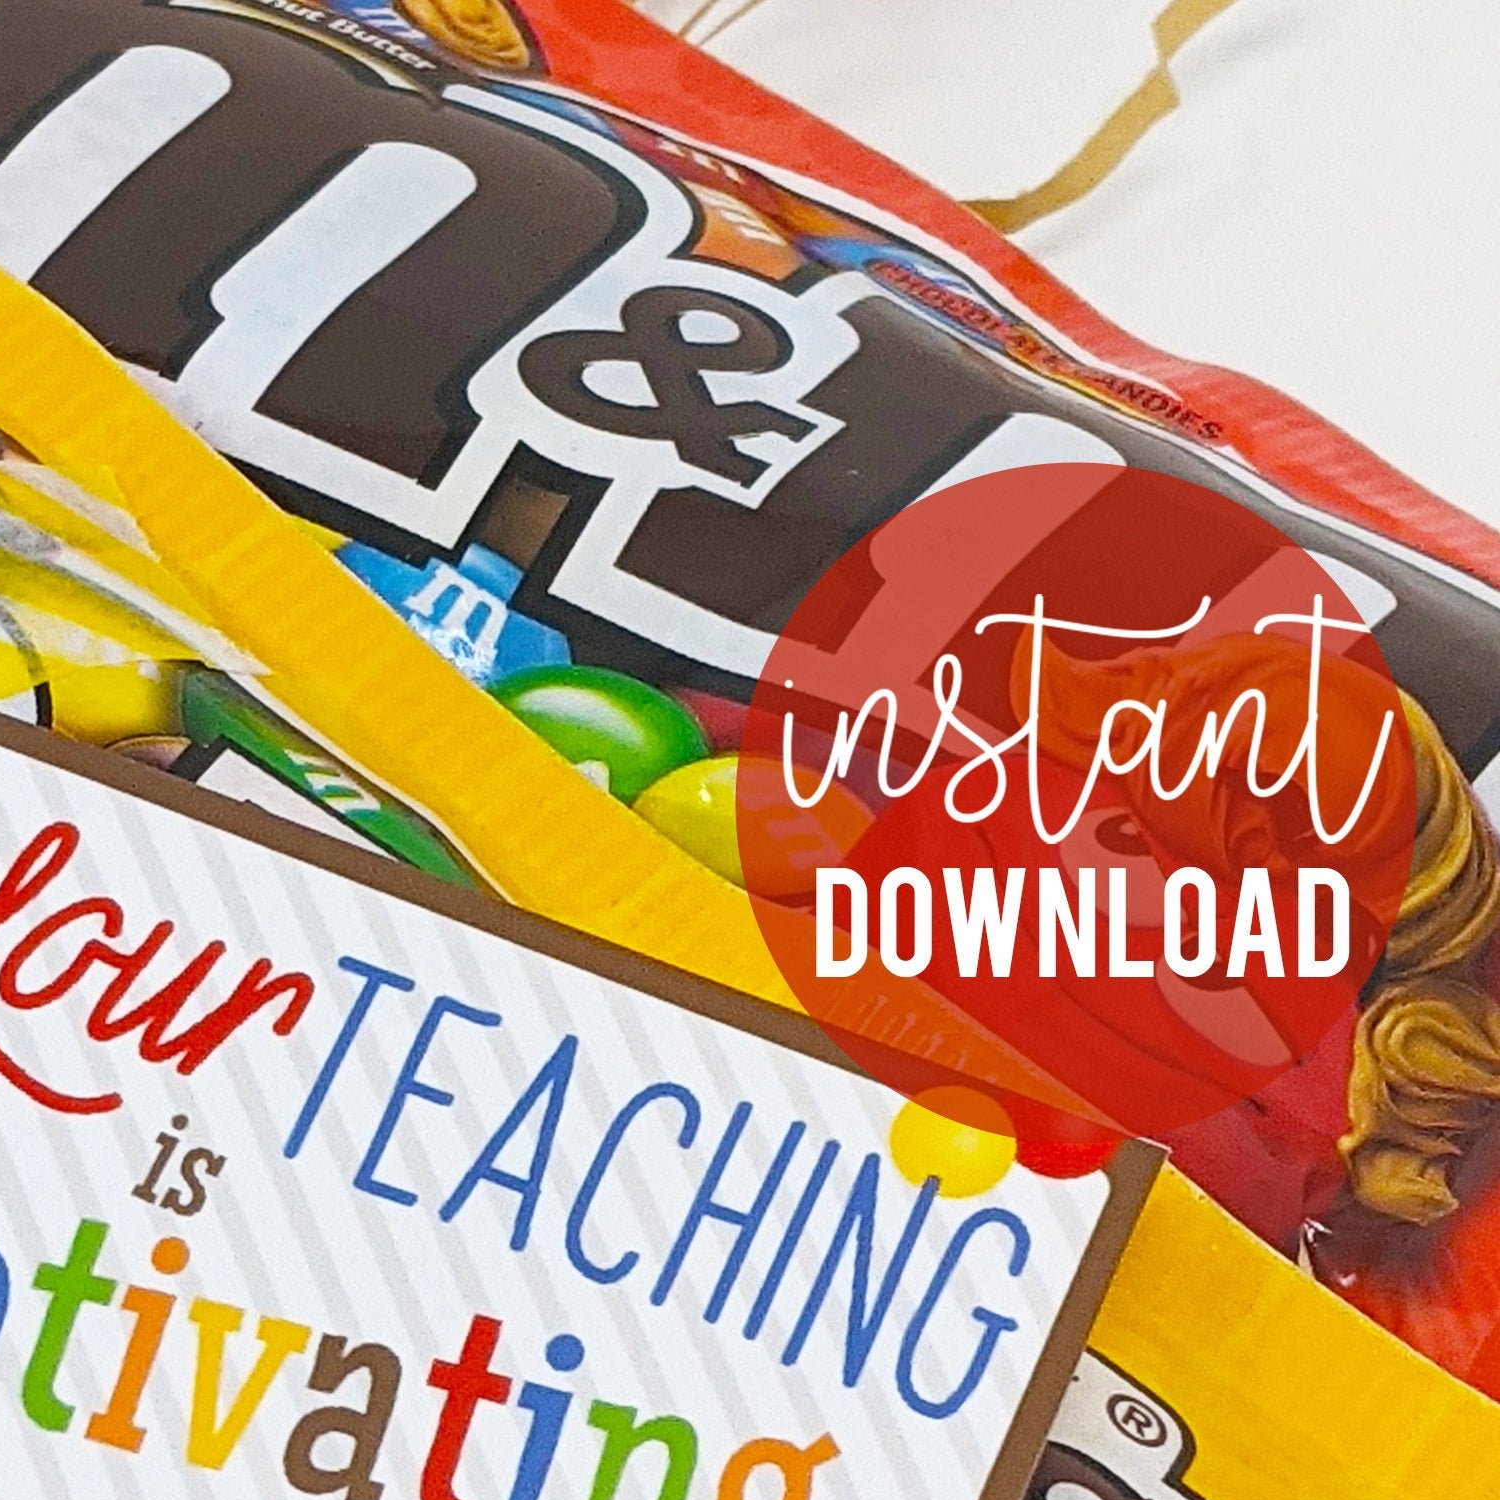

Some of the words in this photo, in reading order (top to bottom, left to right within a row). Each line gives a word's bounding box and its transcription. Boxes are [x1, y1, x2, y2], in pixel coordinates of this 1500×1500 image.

[327, 17, 438, 70] Butter
[131, 1113, 227, 1217] is
[283, 955, 1031, 1420] TEACHING
